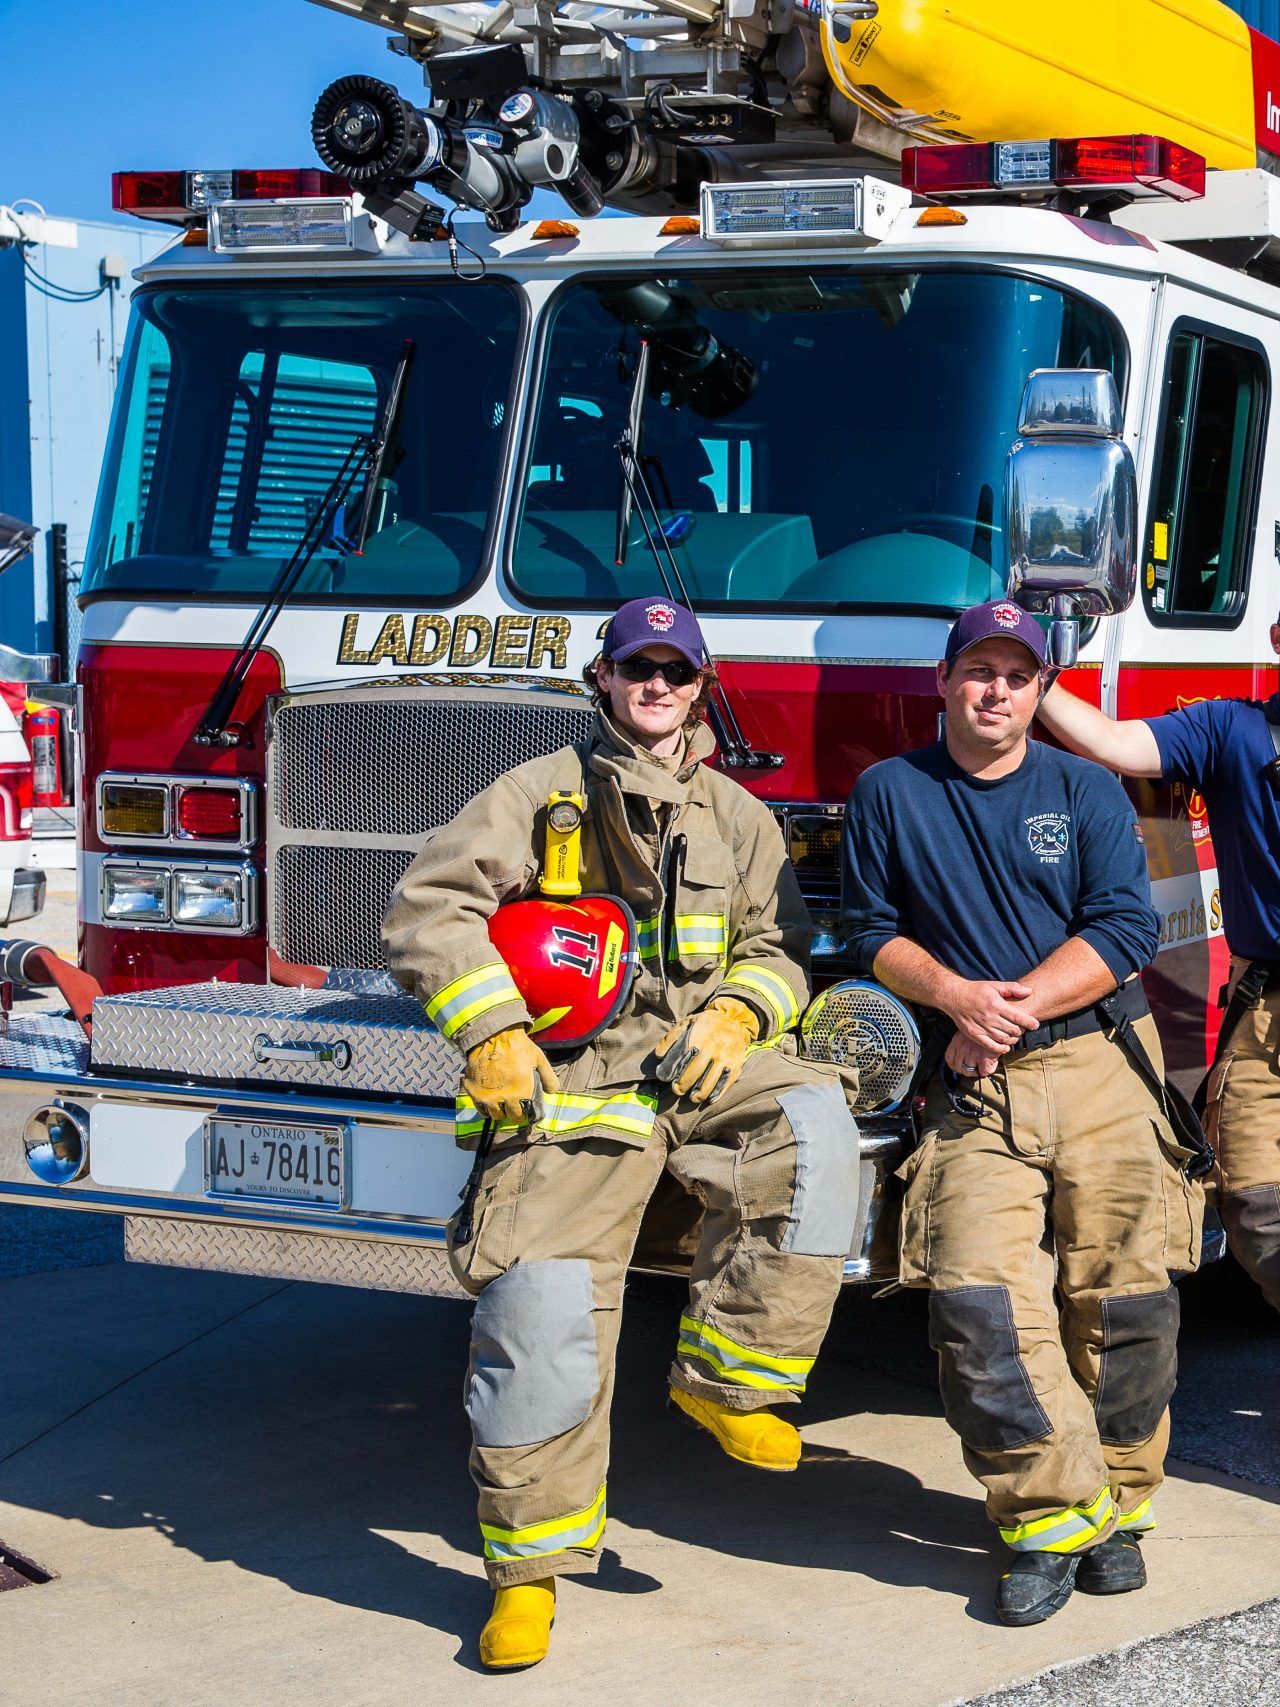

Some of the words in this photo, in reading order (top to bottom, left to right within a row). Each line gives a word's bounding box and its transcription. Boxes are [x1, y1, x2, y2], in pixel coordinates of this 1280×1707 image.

[336, 614, 571, 669] LADDER
[1024, 812, 1058, 825] IMPERIAL
[1060, 813, 1071, 823] OIL
[1040, 856, 1060, 864] FIRE
[550, 925, 598, 978] 11
[251, 1125, 306, 1141] ONTARIO
[216, 1137, 245, 1178] AJ
[262, 1141, 340, 1187] 78416
[246, 1183, 267, 1192] YOURS
[279, 1187, 311, 1196] DISCOVER
